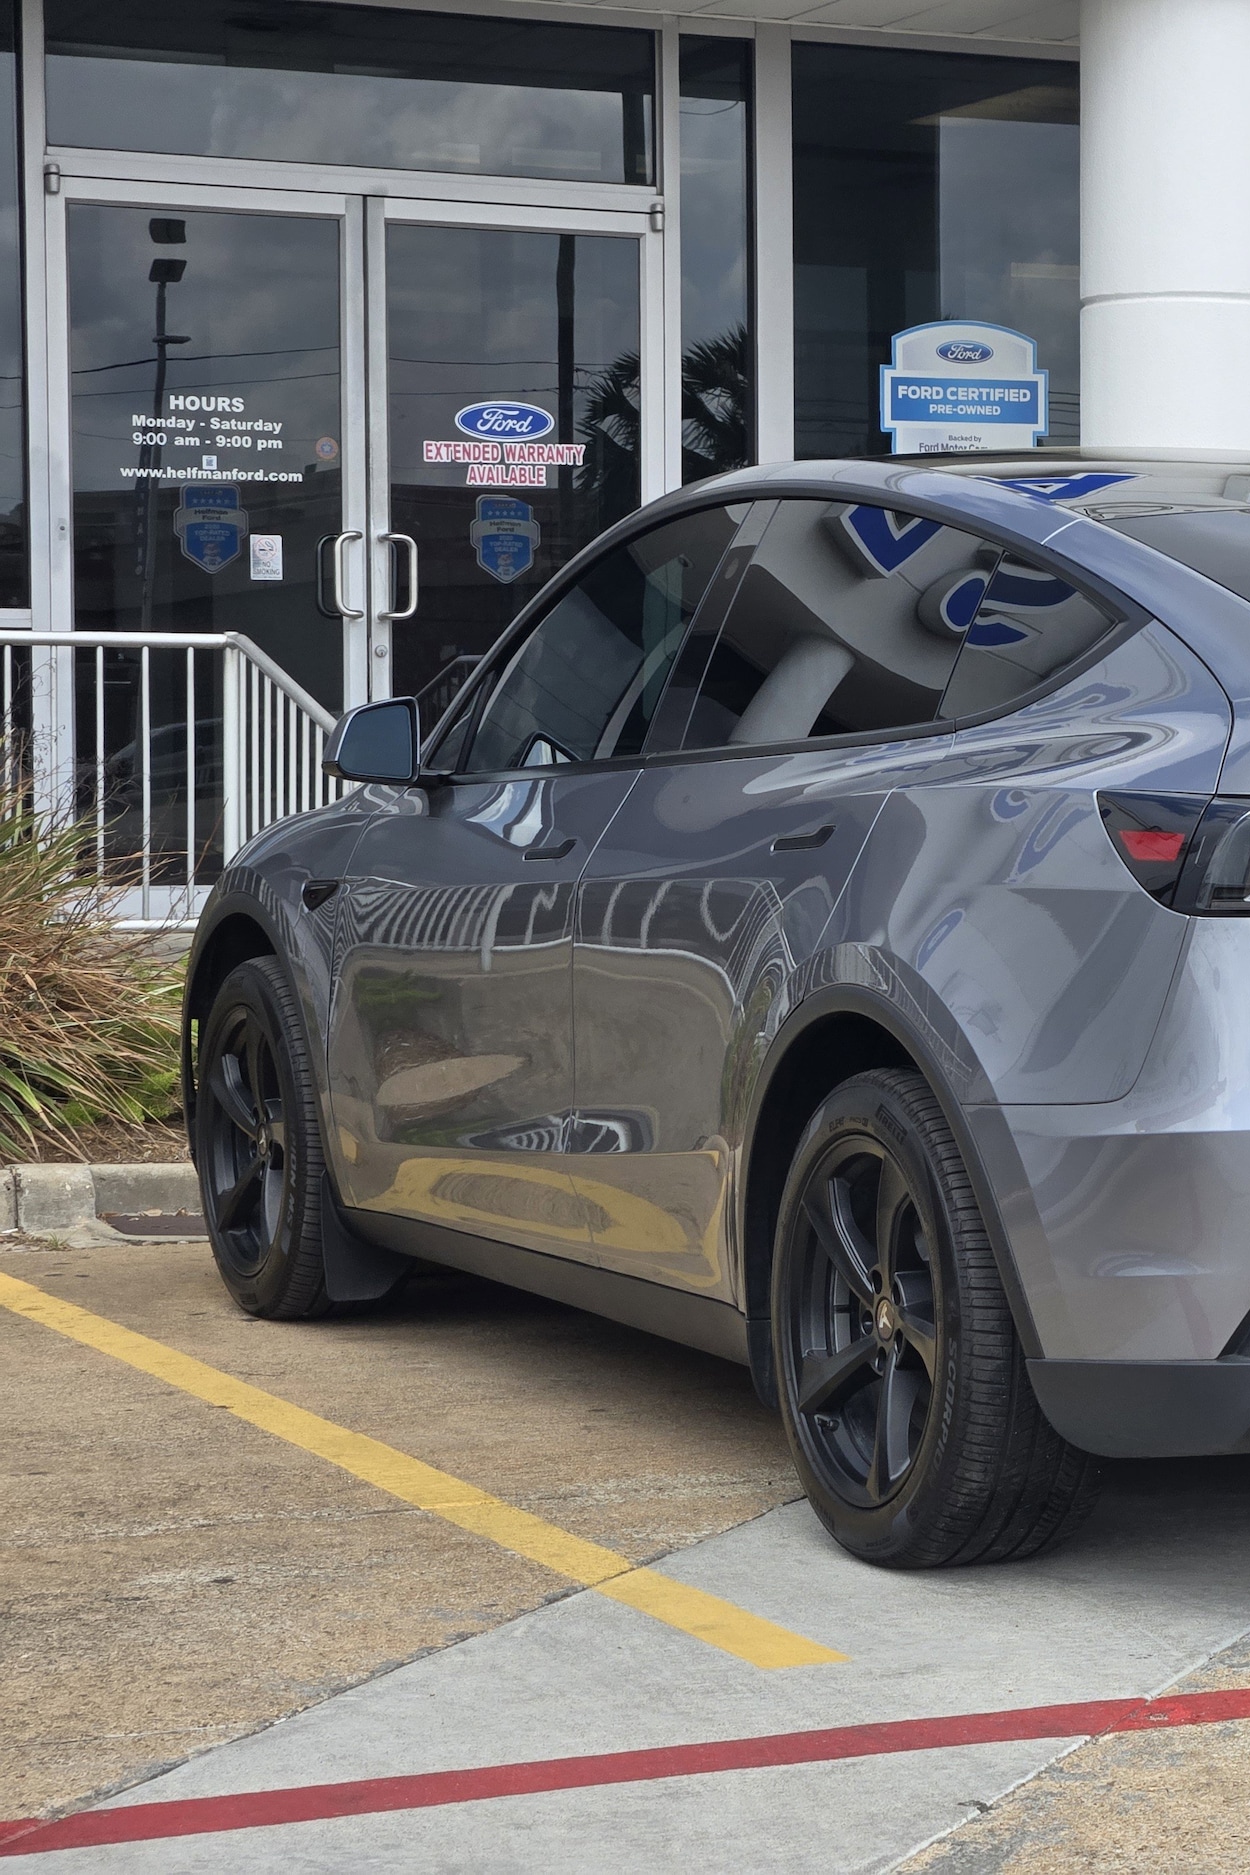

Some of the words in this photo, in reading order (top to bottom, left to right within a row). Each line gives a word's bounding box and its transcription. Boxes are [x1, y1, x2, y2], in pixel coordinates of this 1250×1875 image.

[898, 385, 943, 400] FORD
[946, 387, 1031, 402] CERTIFIED
[169, 395, 245, 412] HOURS
[929, 404, 1001, 415] PRE-OWNED
[132, 415, 195, 431] Monday
[210, 417, 282, 434] Saturday
[476, 407, 534, 433] Ford
[132, 432, 167, 446] 9:00
[174, 436, 200, 446] am
[216, 435, 252, 448] 9:00
[257, 439, 283, 450] pm
[919, 443, 939, 452] Ford
[941, 443, 967, 452] Motor
[974, 435, 982, 443] by
[424, 442, 501, 463] EXTENDED
[504, 444, 586, 465] WARRANTY
[120, 466, 303, 482] www.helfmanford.com
[467, 465, 546, 485] AVAILABLE
[875, 1103, 908, 1146] PIRELLI
[931, 1338, 957, 1484] SCORPIO
